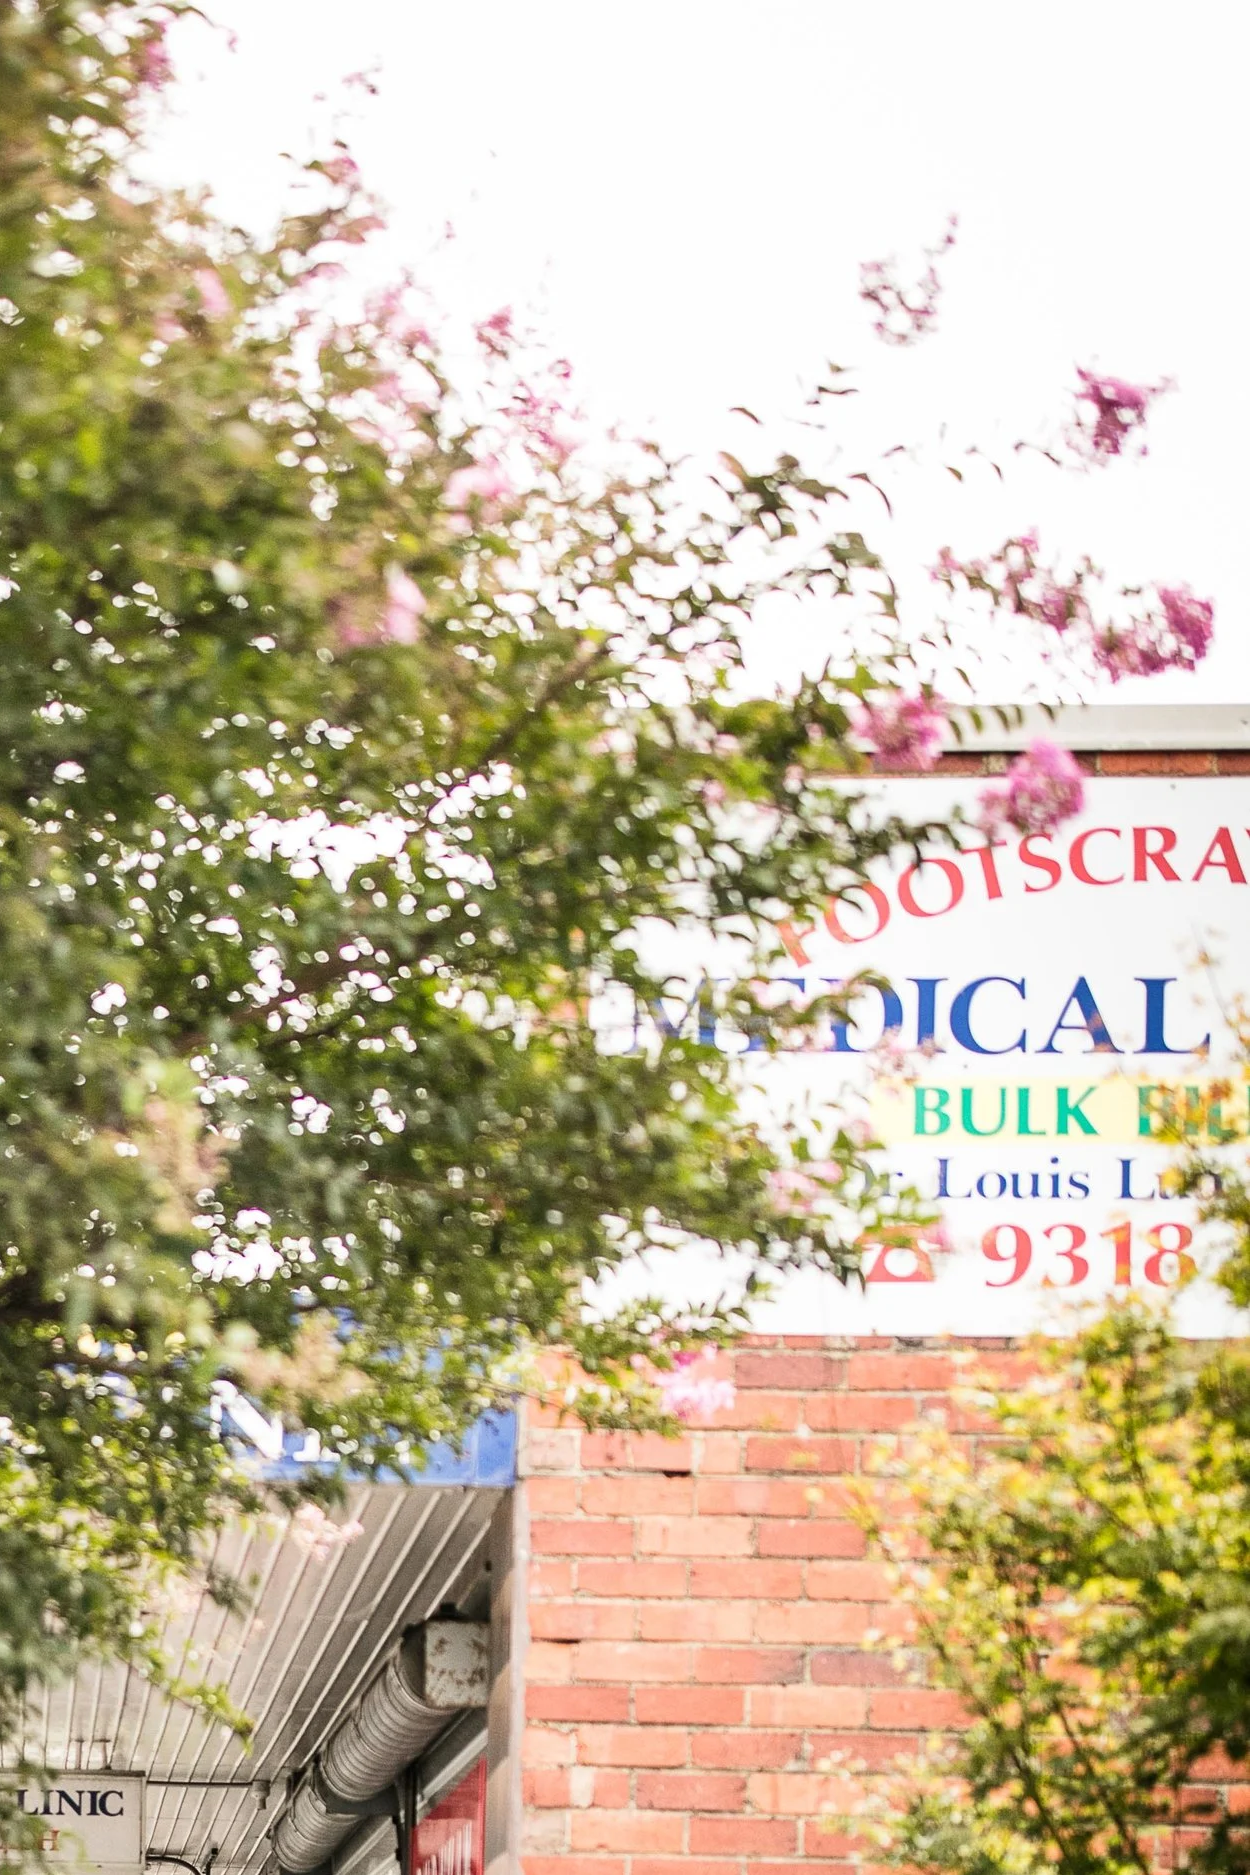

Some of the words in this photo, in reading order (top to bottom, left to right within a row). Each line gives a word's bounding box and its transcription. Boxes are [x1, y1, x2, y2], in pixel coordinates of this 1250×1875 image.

[775, 826, 1250, 968] FOOTSCRA
[620, 976, 1210, 1054] MDICAL
[913, 1086, 1100, 1136] BULK
[934, 1157, 1090, 1199] Louis
[981, 1221, 1198, 1287] 9318
